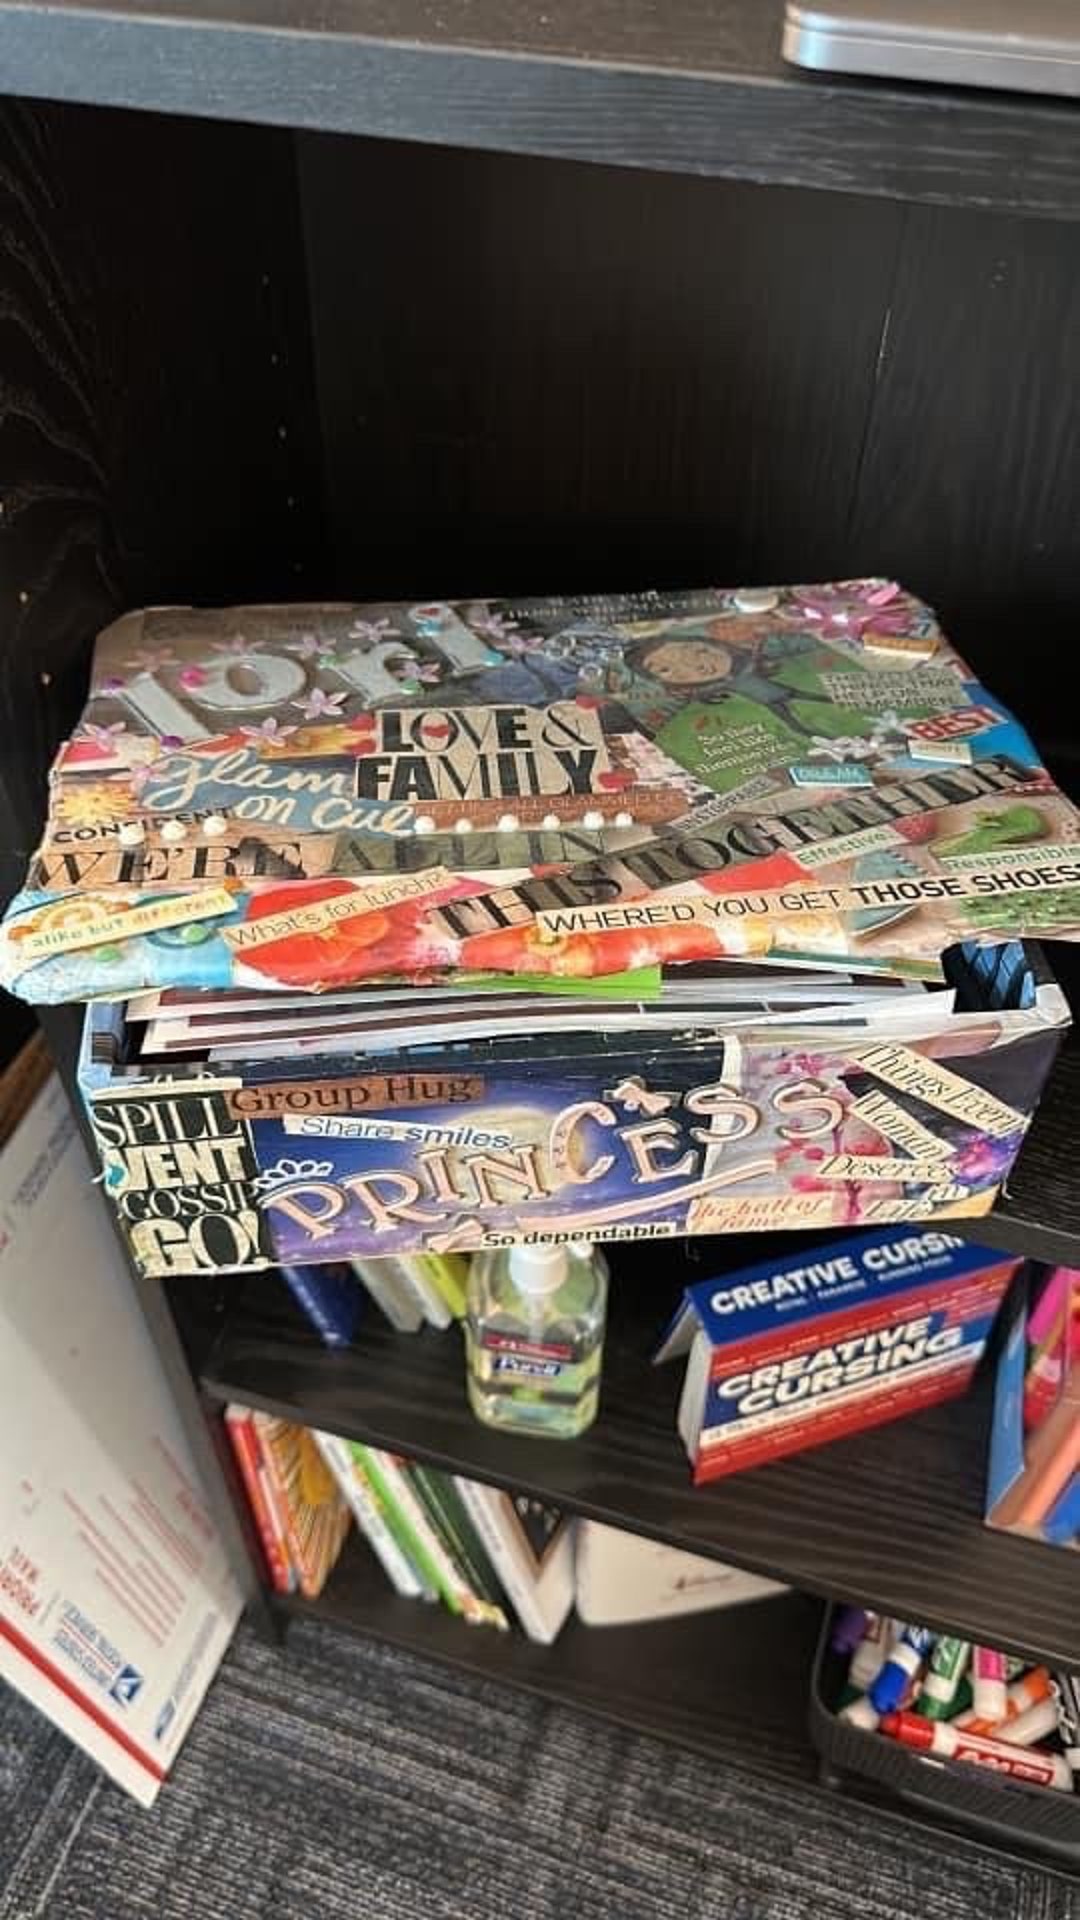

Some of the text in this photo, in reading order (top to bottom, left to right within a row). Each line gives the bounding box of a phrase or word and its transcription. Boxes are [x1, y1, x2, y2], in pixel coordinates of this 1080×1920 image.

[382, 703, 594, 752] LOVE &
[906, 707, 1002, 740] BEST
[357, 749, 598, 800] FAMILY
[620, 757, 1028, 891] TOGETHER
[230, 910, 321, 947] What's
[324, 899, 358, 921] for
[543, 903, 695, 932] WHERE'D
[703, 897, 769, 917] YOU
[779, 889, 842, 912] GET
[852, 876, 966, 906] THOSE
[231, 1076, 473, 1114] Group Hug
[857, 1043, 951, 1098] Things
[91, 1097, 244, 1147] SPILL
[302, 1116, 393, 1140] Share
[104, 1137, 246, 1191] VENT
[258, 1075, 846, 1243] PRINCESS
[484, 1224, 672, 1248] So dependable
[711, 1255, 858, 1316] CREATIVE
[716, 1316, 935, 1400] CREATIVE
[736, 1327, 963, 1414] CURSING
